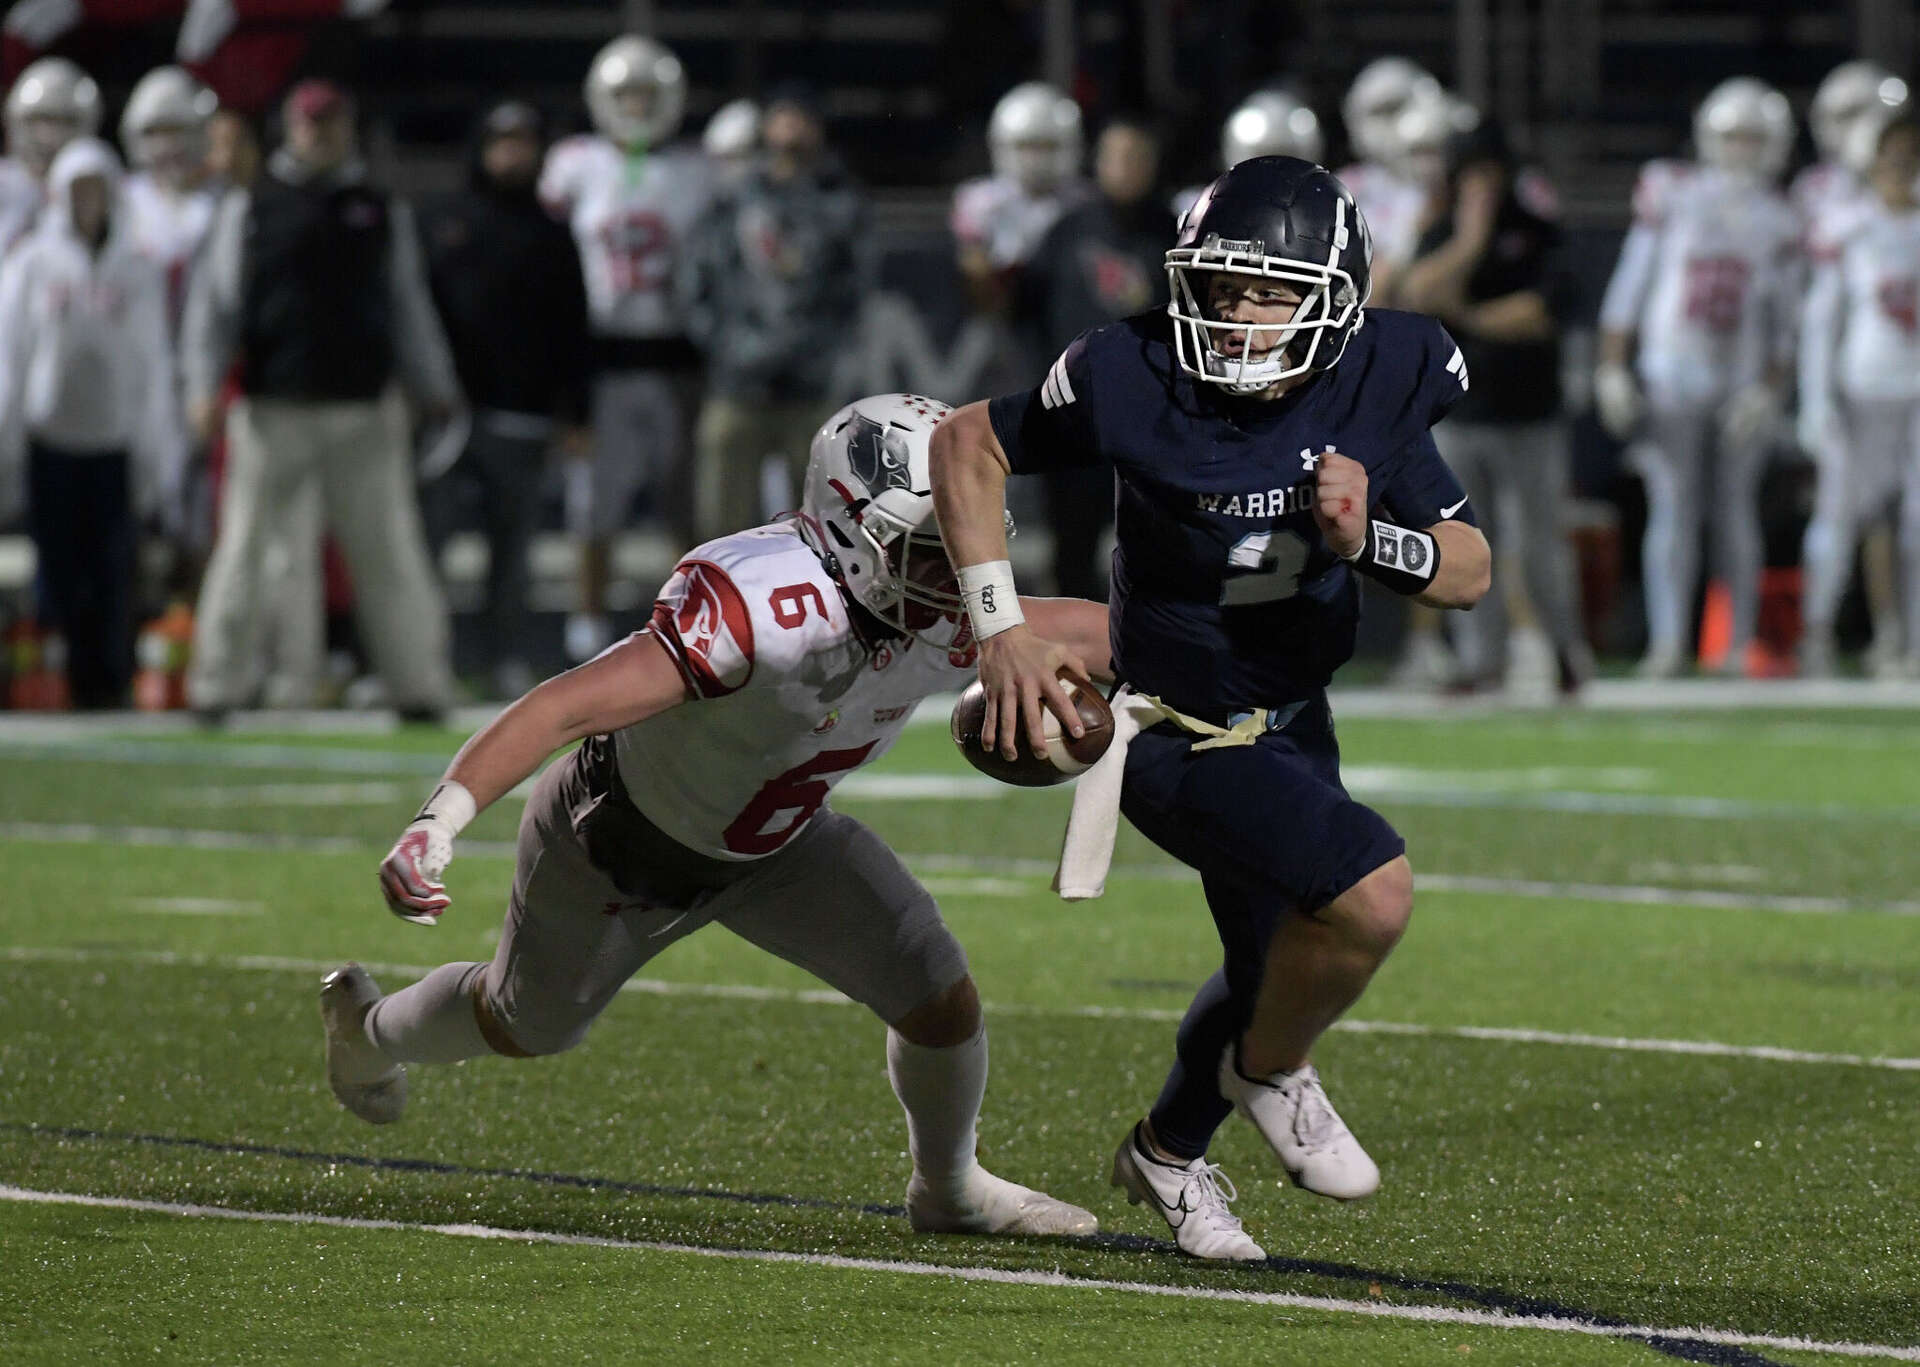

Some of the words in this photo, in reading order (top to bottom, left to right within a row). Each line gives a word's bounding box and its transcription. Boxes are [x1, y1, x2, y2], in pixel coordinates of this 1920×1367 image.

[1196, 485, 1314, 518] WARRIO
[1219, 529, 1310, 606] 2
[768, 582, 830, 630] 6
[722, 738, 881, 855] 6
